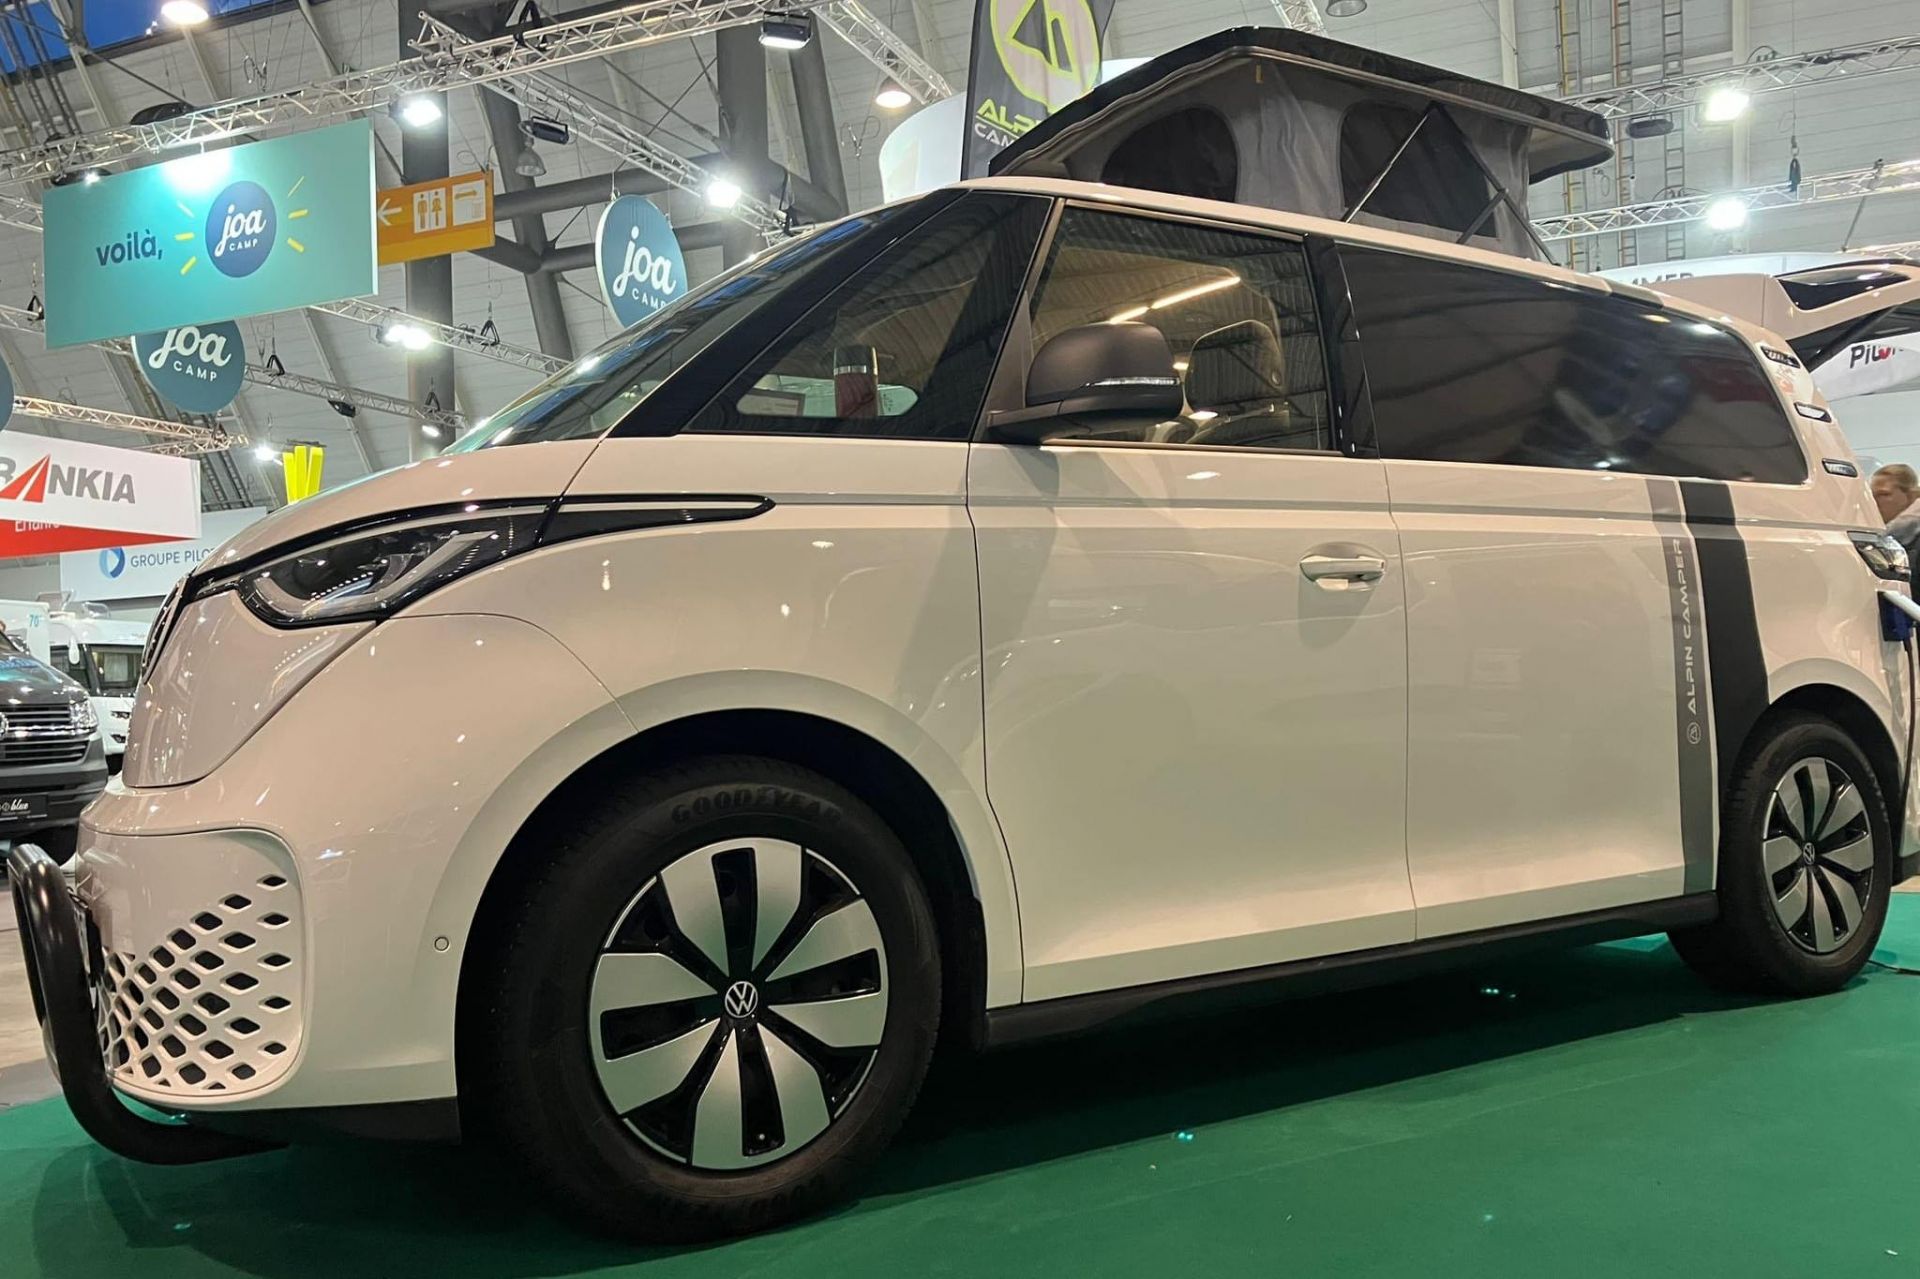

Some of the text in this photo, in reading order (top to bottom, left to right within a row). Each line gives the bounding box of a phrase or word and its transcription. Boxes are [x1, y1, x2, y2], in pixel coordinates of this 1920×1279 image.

[976, 99, 1042, 133] ALP
[97, 229, 163, 267] voilà,
[214, 204, 267, 257] joa
[229, 238, 258, 252] CAMP
[613, 226, 677, 297] joa
[148, 326, 232, 369] joa
[173, 360, 217, 381] CAMP
[130, 547, 215, 568] GROUPE PILO
[1674, 540, 1697, 715] ALPIN CAMPER
[671, 788, 842, 824] GOODYEAR
